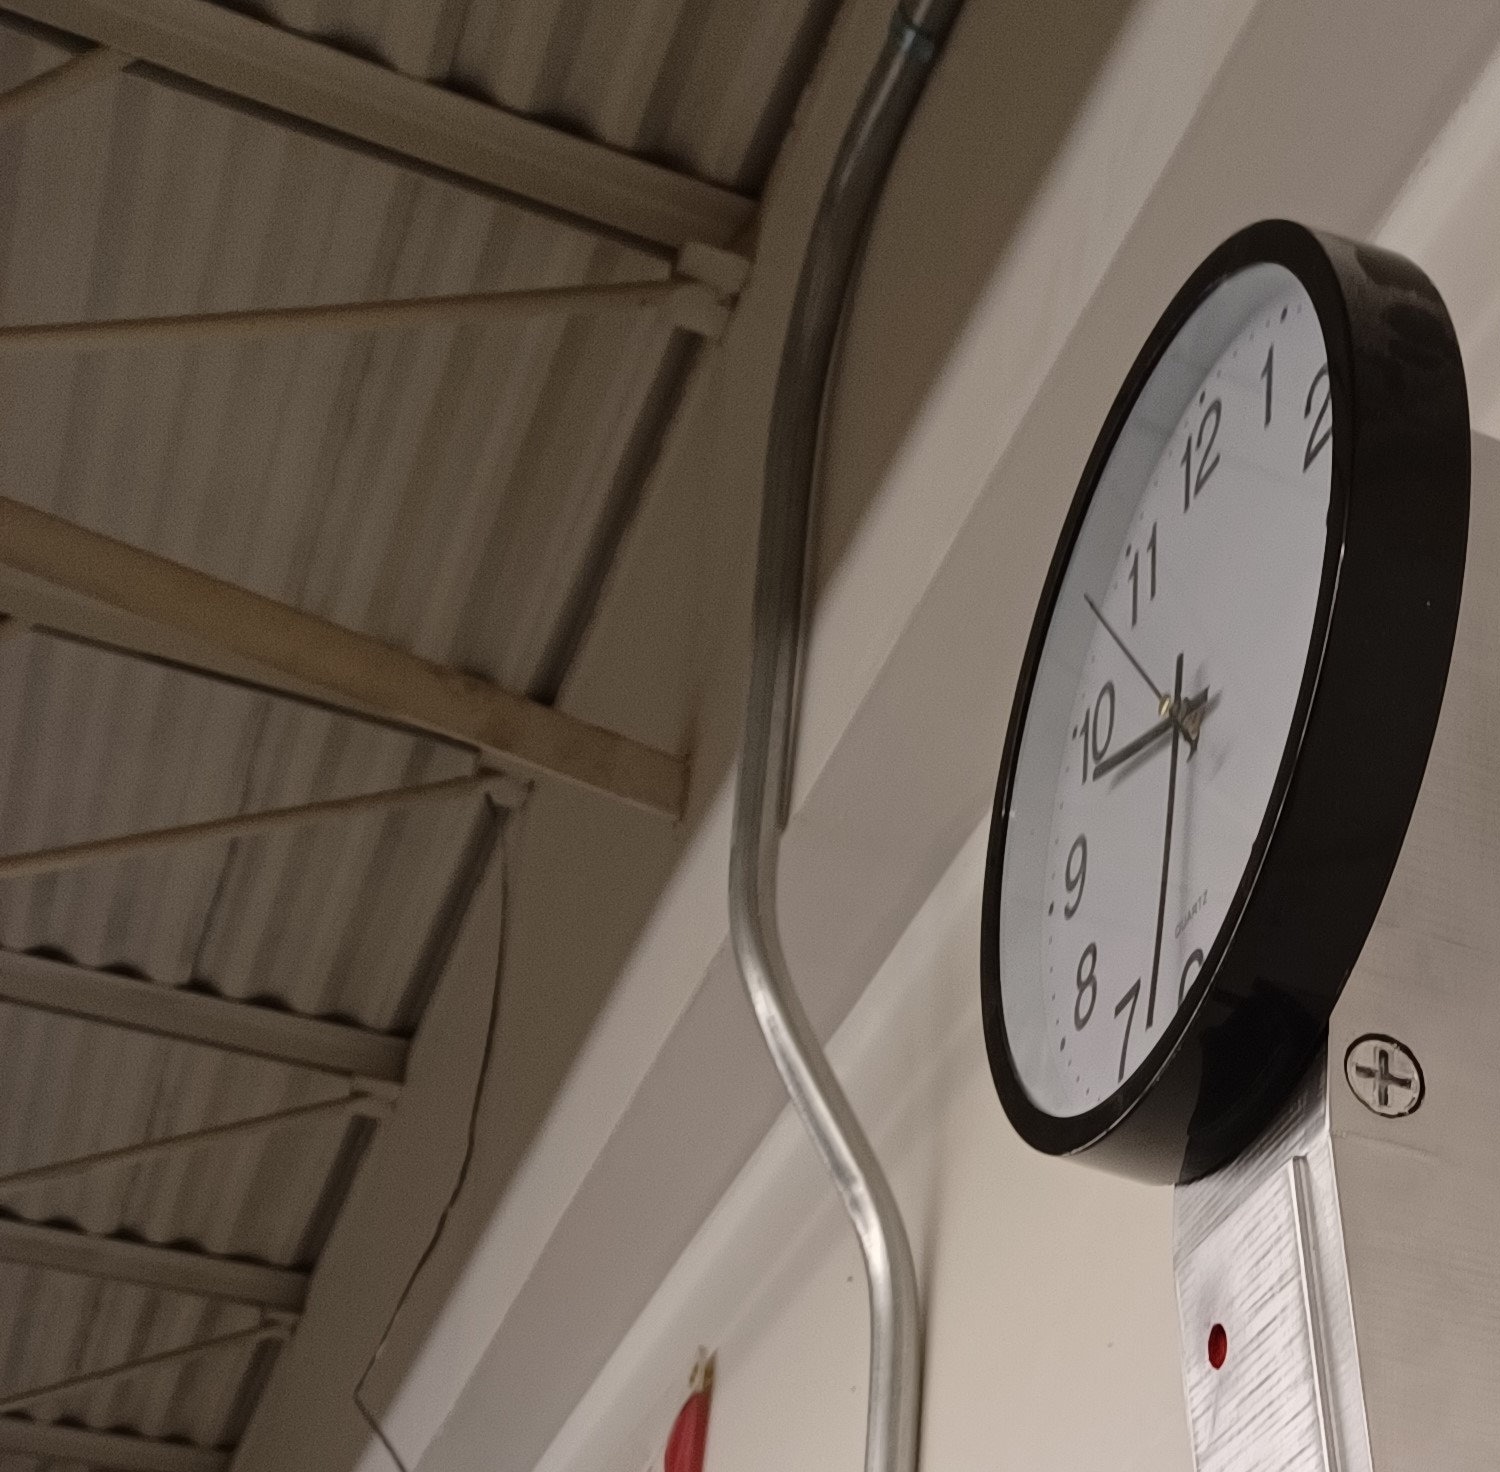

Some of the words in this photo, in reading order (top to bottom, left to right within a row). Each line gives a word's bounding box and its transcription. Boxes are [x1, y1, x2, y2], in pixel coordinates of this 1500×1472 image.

[1259, 341, 1276, 429] 1
[1180, 398, 1222, 513] 12
[1126, 521, 1158, 630] 11
[1077, 680, 1117, 786] 10
[1064, 834, 1088, 920] 9
[1175, 890, 1208, 938] QUARTZ
[1073, 941, 1098, 1032] 8
[1113, 978, 1141, 1084] 7
